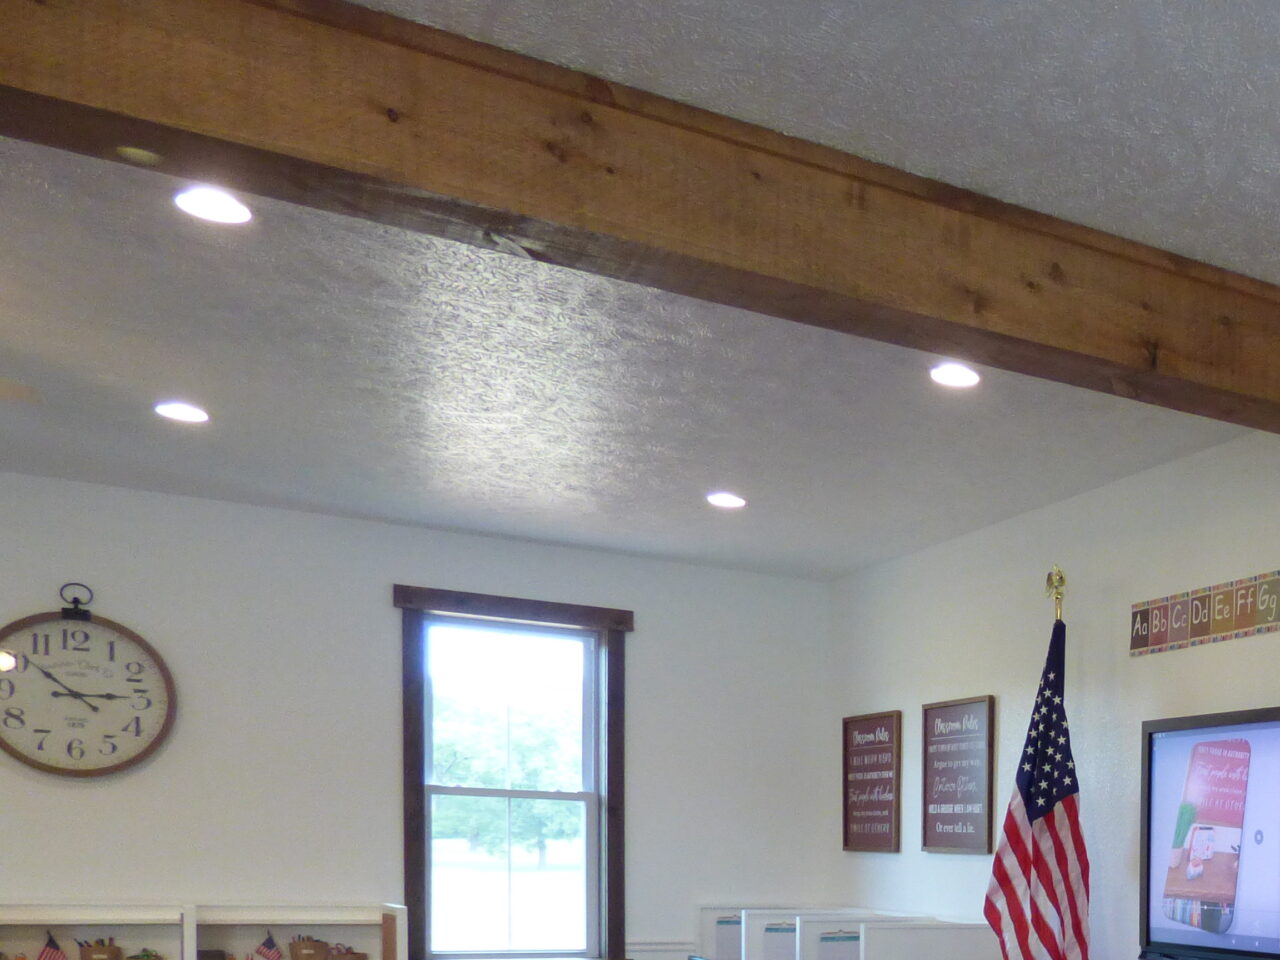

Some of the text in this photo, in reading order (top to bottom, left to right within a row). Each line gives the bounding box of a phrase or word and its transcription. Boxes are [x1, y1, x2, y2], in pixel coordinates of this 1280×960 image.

[1132, 614, 1148, 637] Aa
[1152, 610, 1167, 633] Bb
[1172, 605, 1187, 628] Cc
[1192, 599, 1208, 624] Dd
[1215, 595, 1230, 620] Ee
[1237, 587, 1254, 615] Ff
[1258, 585, 1277, 621] Gg
[32, 633, 50, 656] 11
[62, 628, 90, 652] 12
[108, 640, 115, 662] 1
[125, 662, 144, 683] 2
[131, 688, 152, 711] 3
[3, 706, 26, 729] 8
[121, 716, 143, 737] 4
[33, 728, 51, 751] 7
[66, 738, 85, 760] 6
[99, 734, 118, 756] 5
